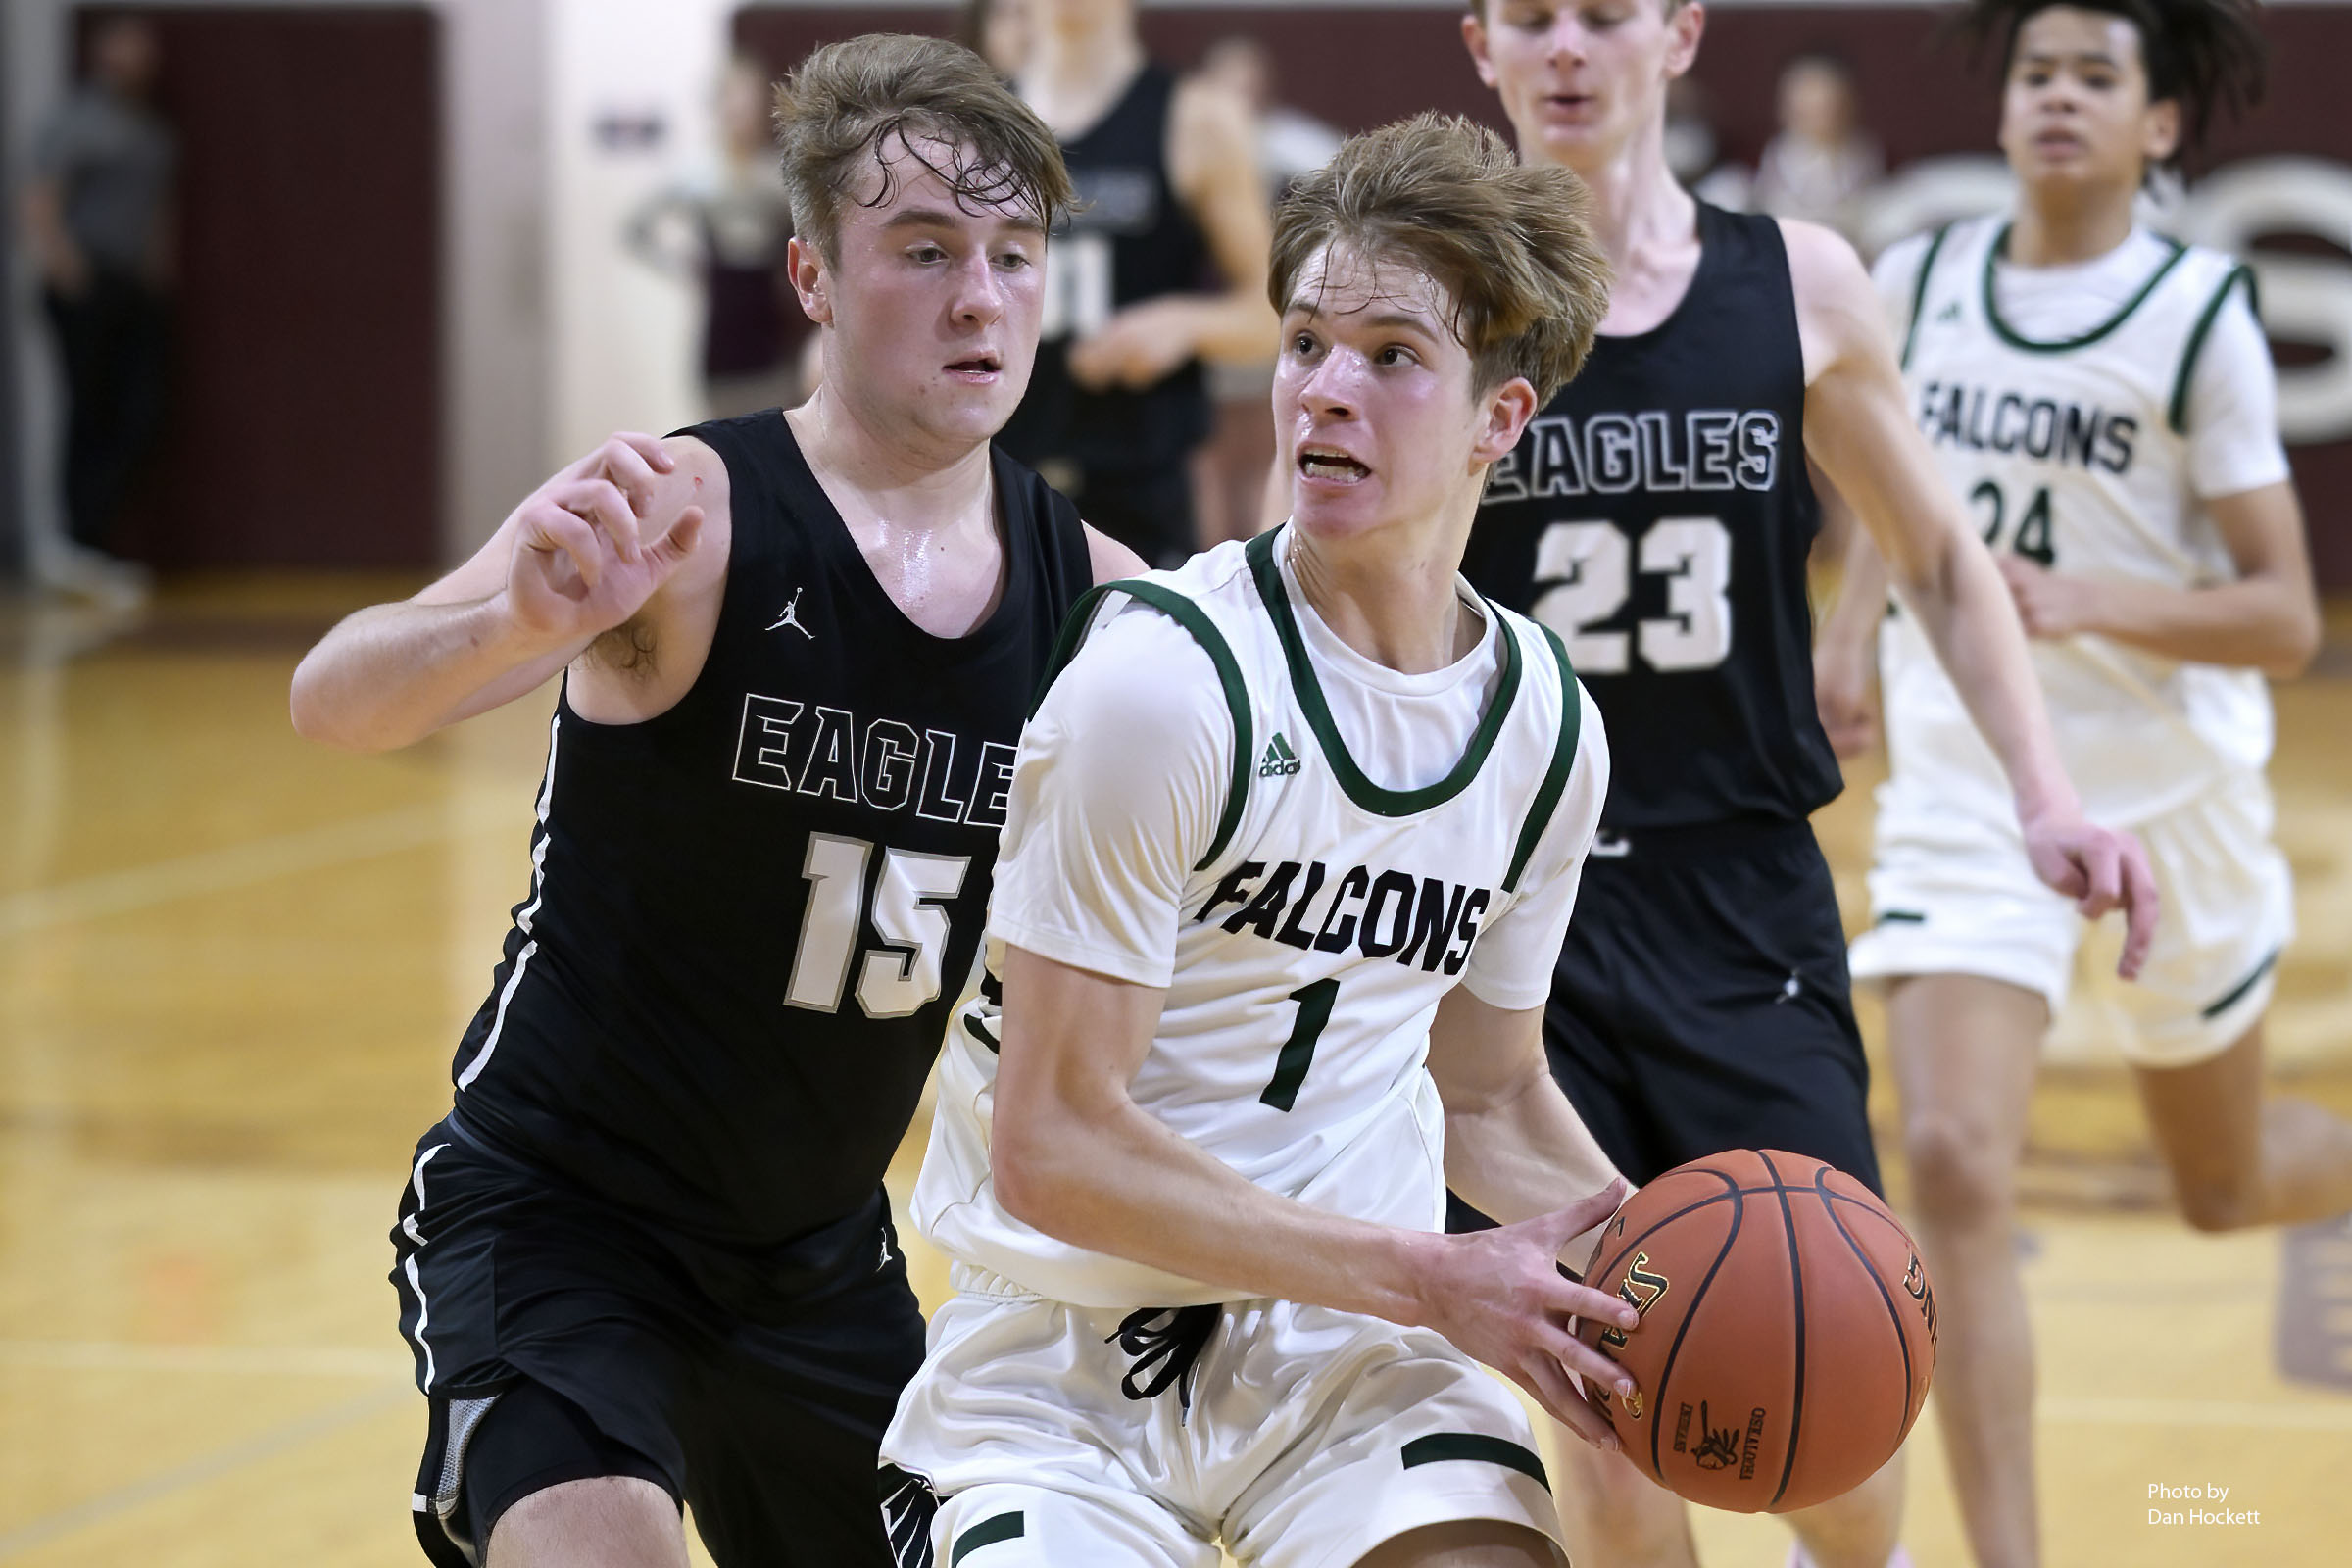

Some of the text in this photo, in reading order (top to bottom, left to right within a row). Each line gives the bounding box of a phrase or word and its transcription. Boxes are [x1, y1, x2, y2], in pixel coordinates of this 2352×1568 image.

[1919, 381, 2138, 474] FALCONS
[1970, 480, 2056, 568] 24
[1531, 516, 1732, 675] 23
[732, 693, 1018, 827] EAGLE
[783, 831, 972, 1019] 15
[1193, 860, 1491, 976] FALCONS
[1259, 977, 1341, 1113] 1
